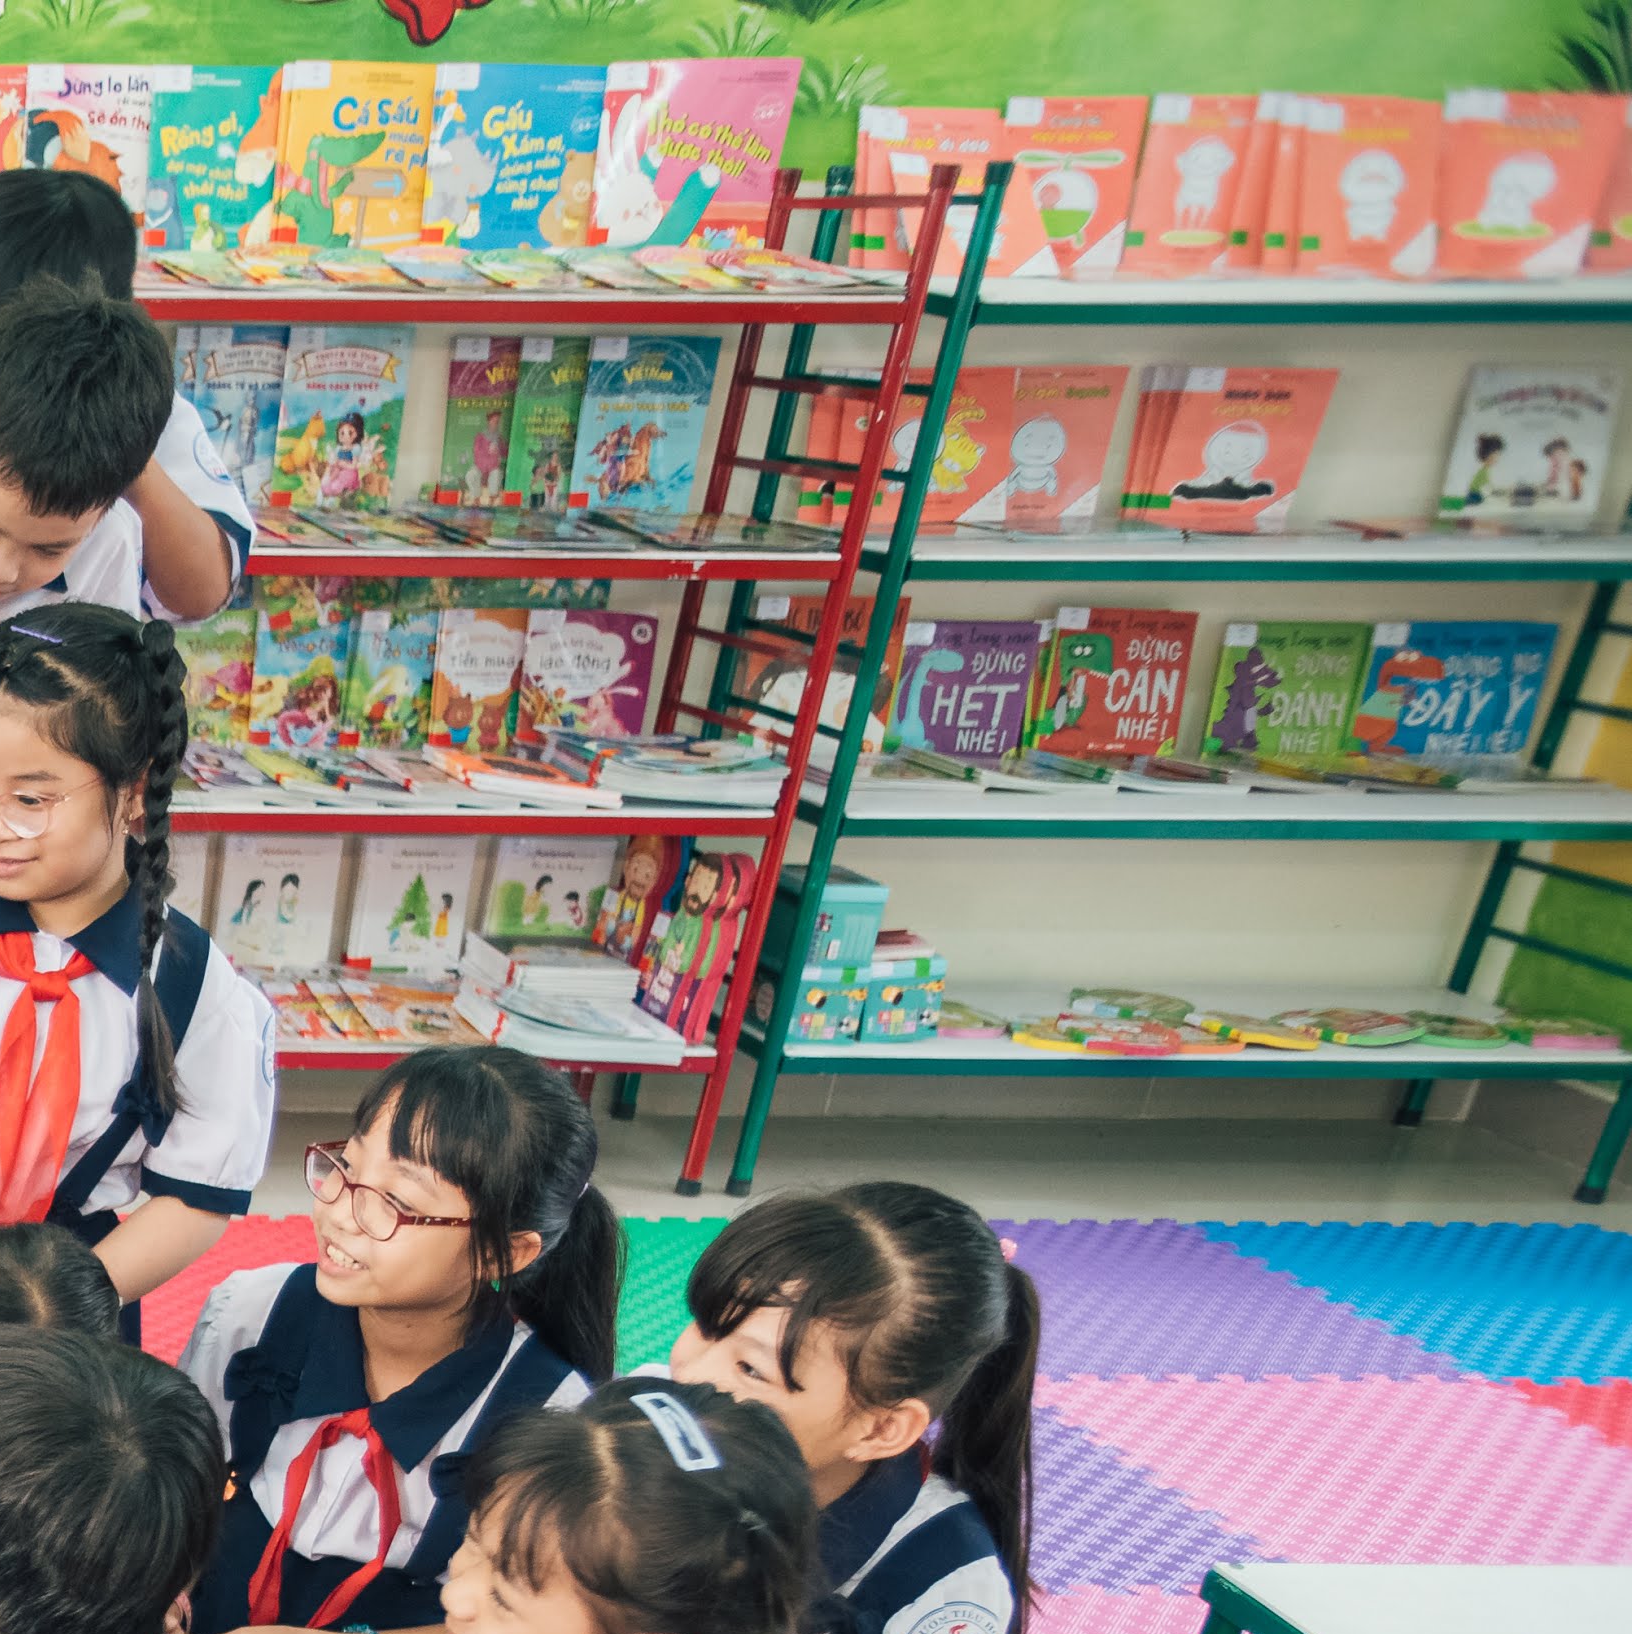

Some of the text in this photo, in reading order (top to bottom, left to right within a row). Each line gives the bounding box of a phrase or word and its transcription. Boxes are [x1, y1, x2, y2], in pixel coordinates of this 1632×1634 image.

[970, 647, 1027, 675] ĐỪNG
[1126, 634, 1184, 662] ĐỪNG
[929, 672, 1021, 728] HÉT
[1104, 659, 1181, 715] CẮN
[1267, 680, 1349, 728] ĐÁNH
